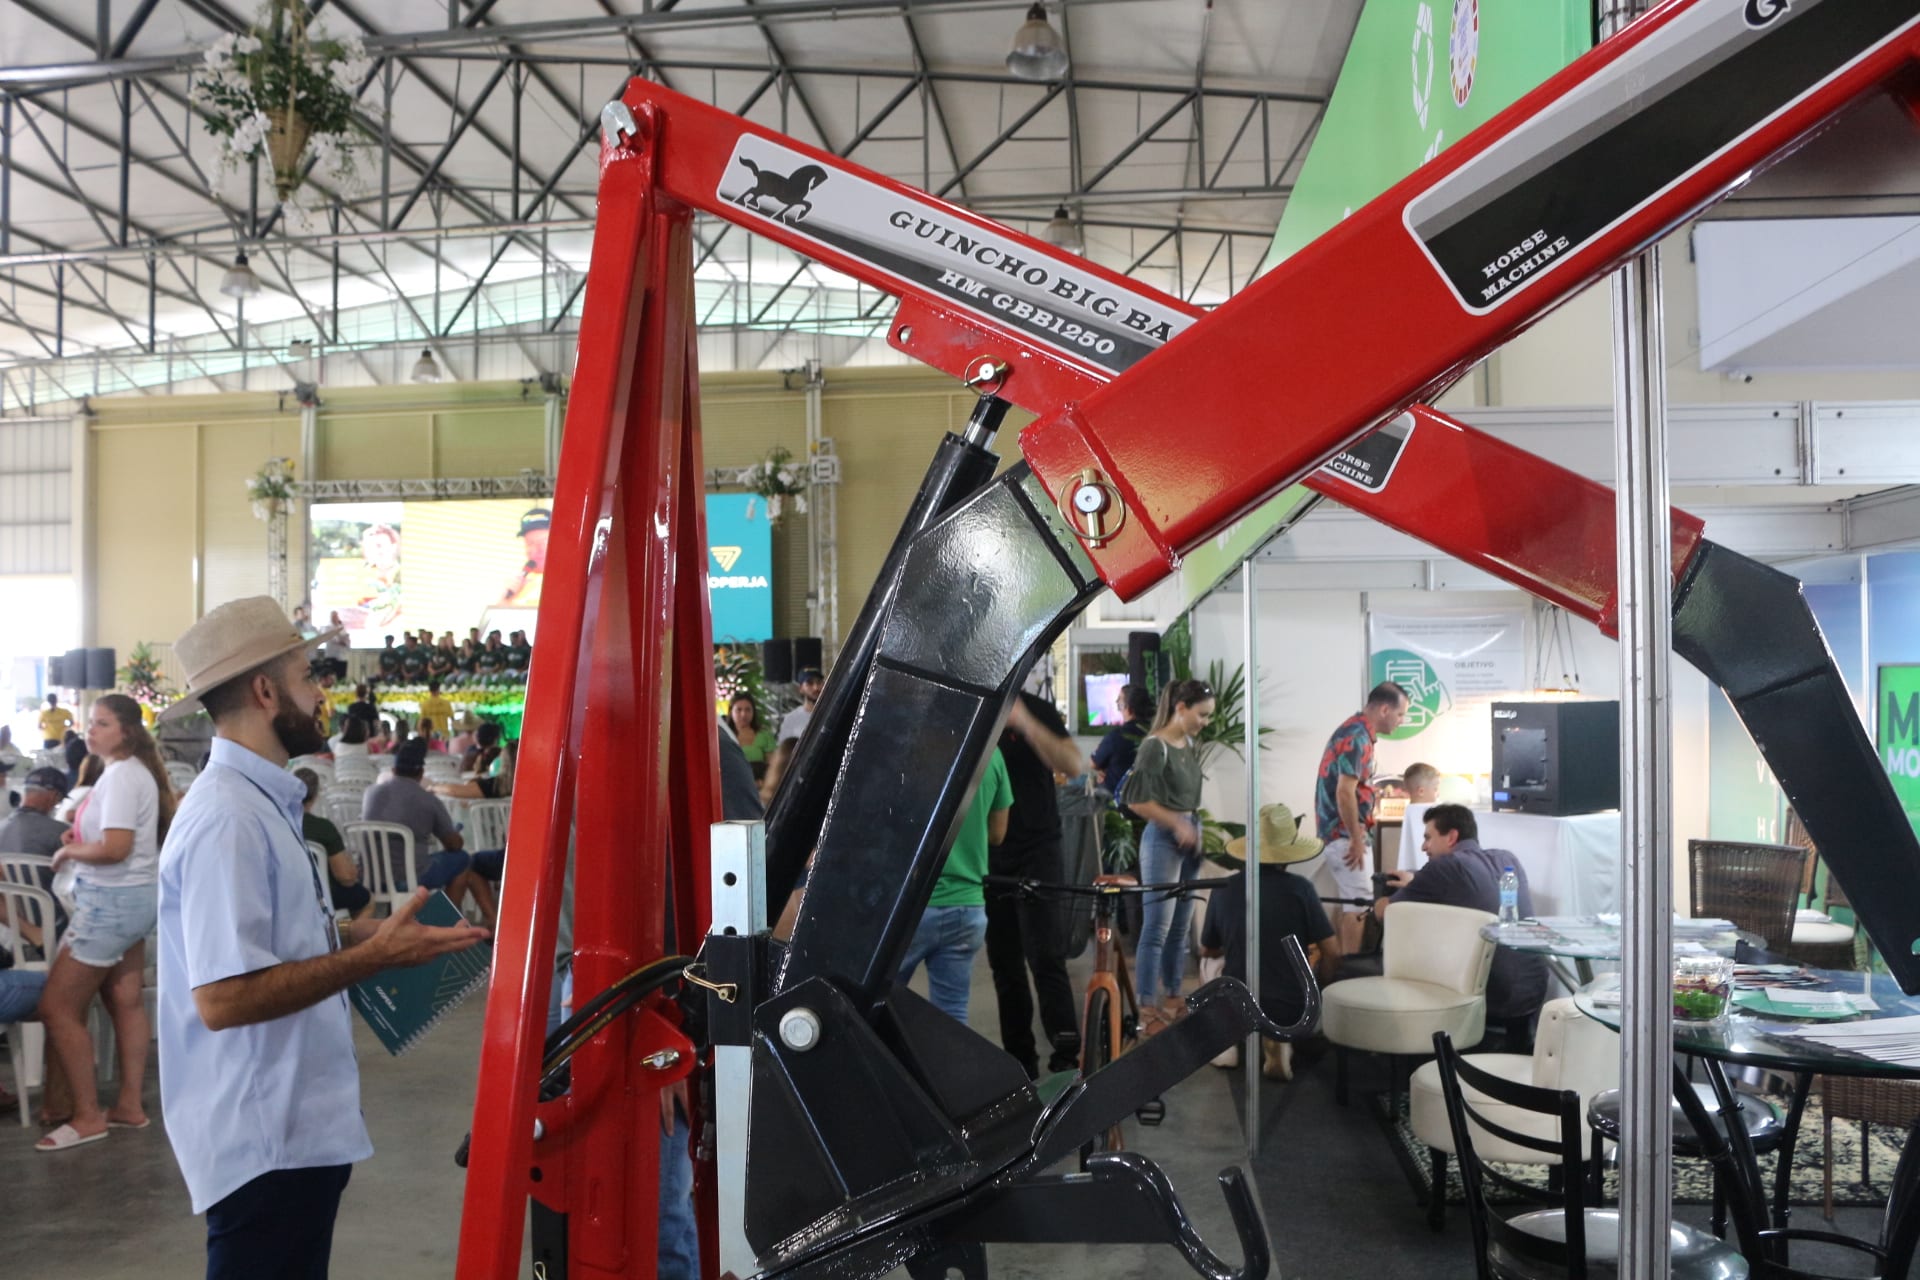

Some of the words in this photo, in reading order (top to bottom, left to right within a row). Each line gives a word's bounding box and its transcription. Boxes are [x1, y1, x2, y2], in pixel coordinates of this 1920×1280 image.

[889, 210, 1048, 285] GUINCHO
[1048, 277, 1120, 317] BIG
[1481, 235, 1570, 301] MACHINE
[1482, 229, 1548, 279] HORSE
[938, 268, 1115, 355] HM-GBB1250
